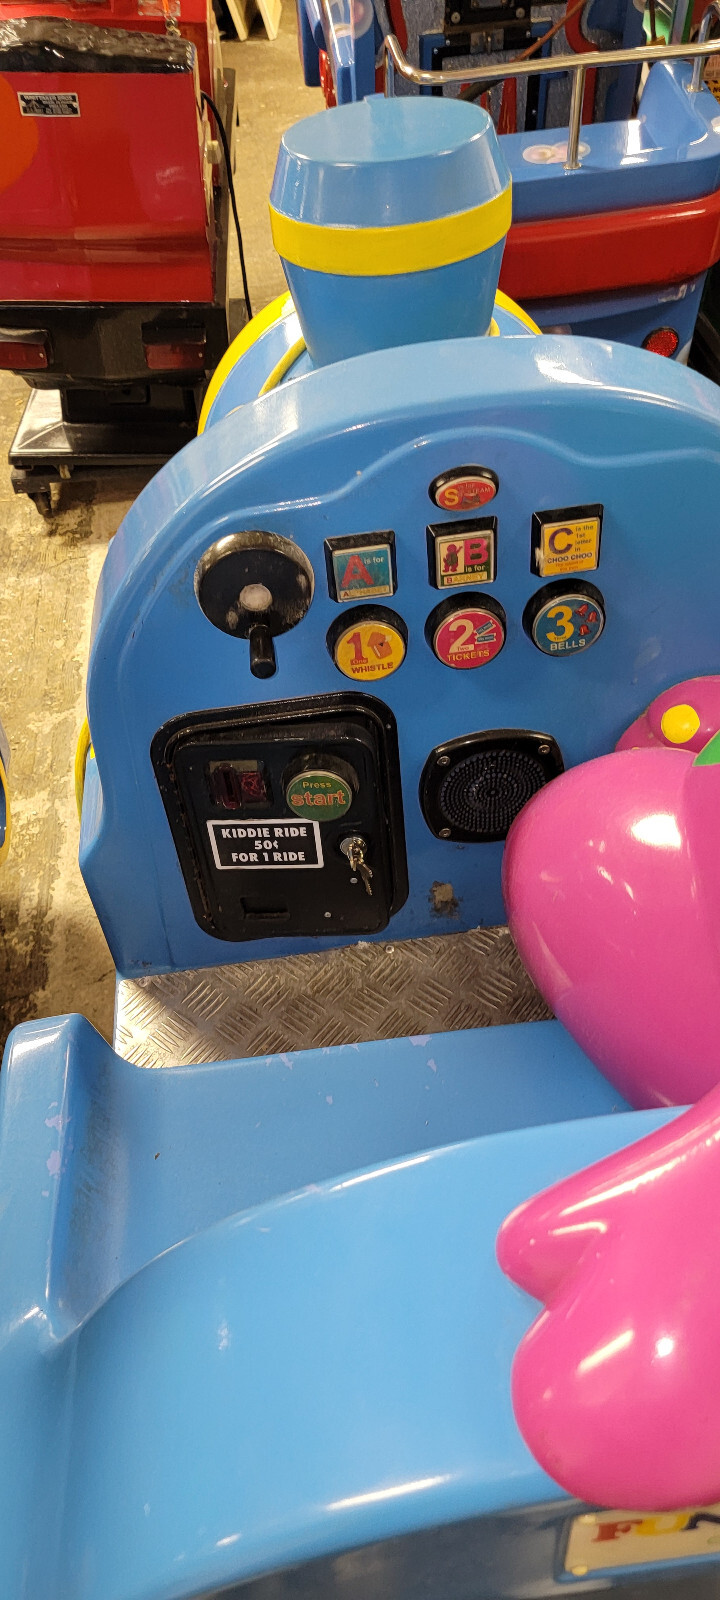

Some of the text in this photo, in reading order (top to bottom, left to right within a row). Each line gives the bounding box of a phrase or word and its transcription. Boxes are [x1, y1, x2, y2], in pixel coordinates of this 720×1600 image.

[444, 488, 459, 506] S
[548, 527, 574, 555] C
[464, 537, 489, 566] B
[547, 556, 569, 564] CHOO
[570, 552, 593, 561] CHOO
[341, 554, 375, 588] A
[474, 564, 486, 572] for
[546, 605, 574, 643] 3
[448, 618, 474, 653] 2
[346, 632, 368, 661] 1
[550, 638, 586, 651] BELLS
[446, 649, 490, 662] TICKETS
[350, 661, 394, 674] WHISTLE
[302, 781, 332, 789] Press
[290, 789, 346, 807] start
[221, 826, 307, 839] KIDDIE RIDE
[254, 839, 279, 850] 50¢
[231, 851, 306, 863] FOR 1 RIDE
